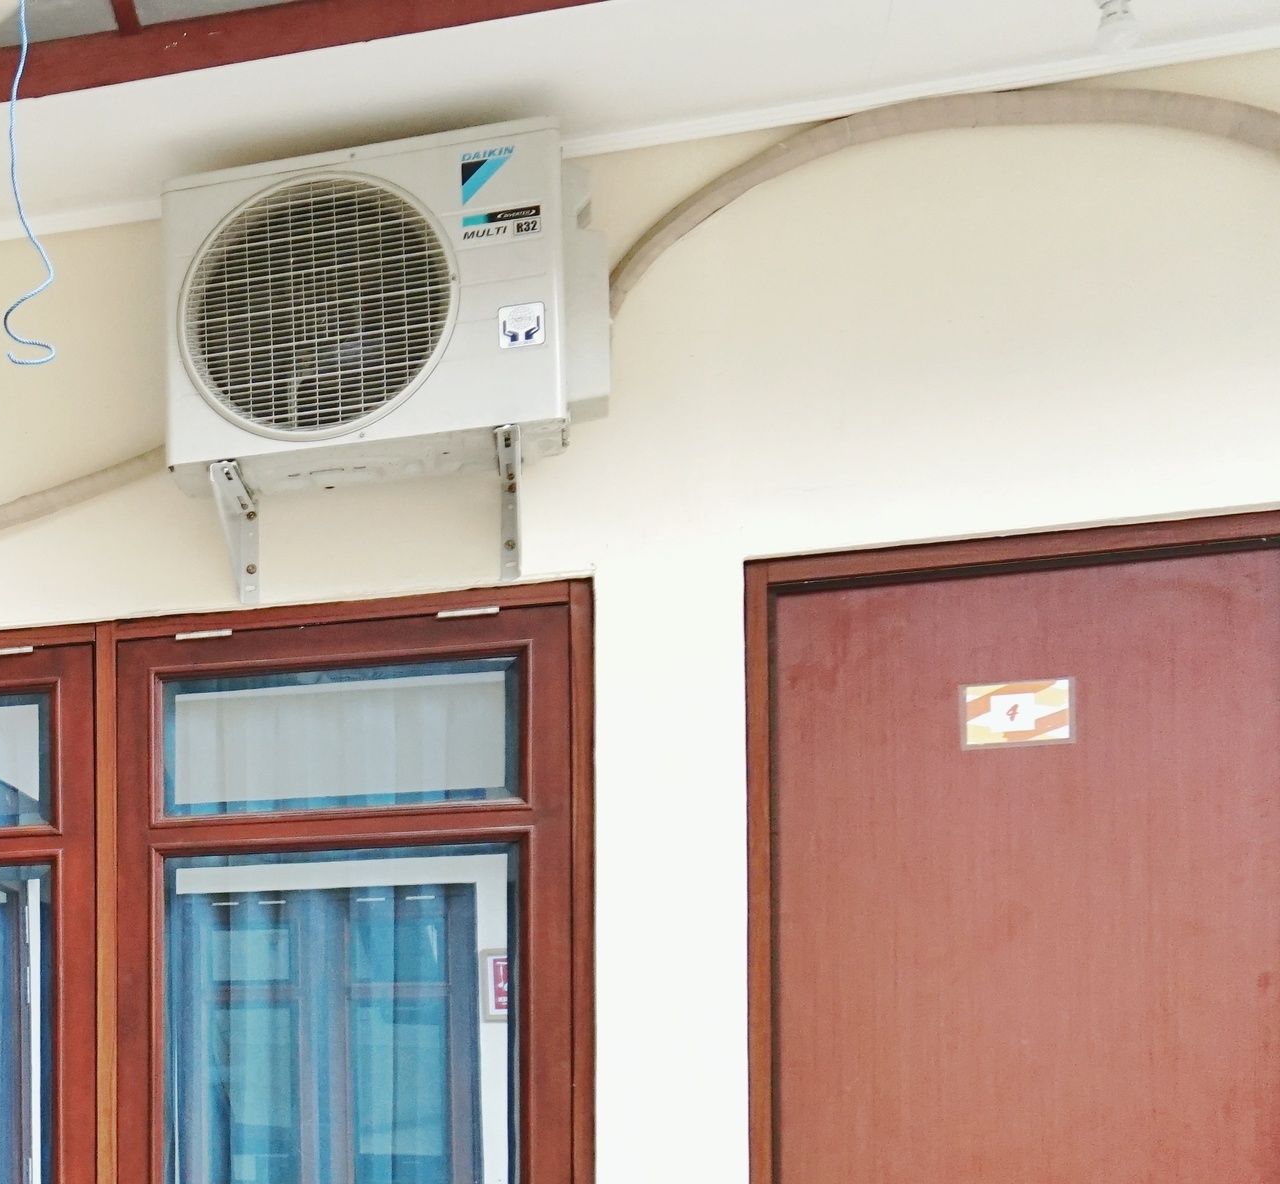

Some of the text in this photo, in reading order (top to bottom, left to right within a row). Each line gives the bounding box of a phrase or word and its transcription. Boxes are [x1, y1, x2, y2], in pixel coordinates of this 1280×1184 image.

[461, 146, 514, 161] DAIKIN
[463, 220, 538, 240] MULTI R32
[1006, 704, 1019, 721] 4
